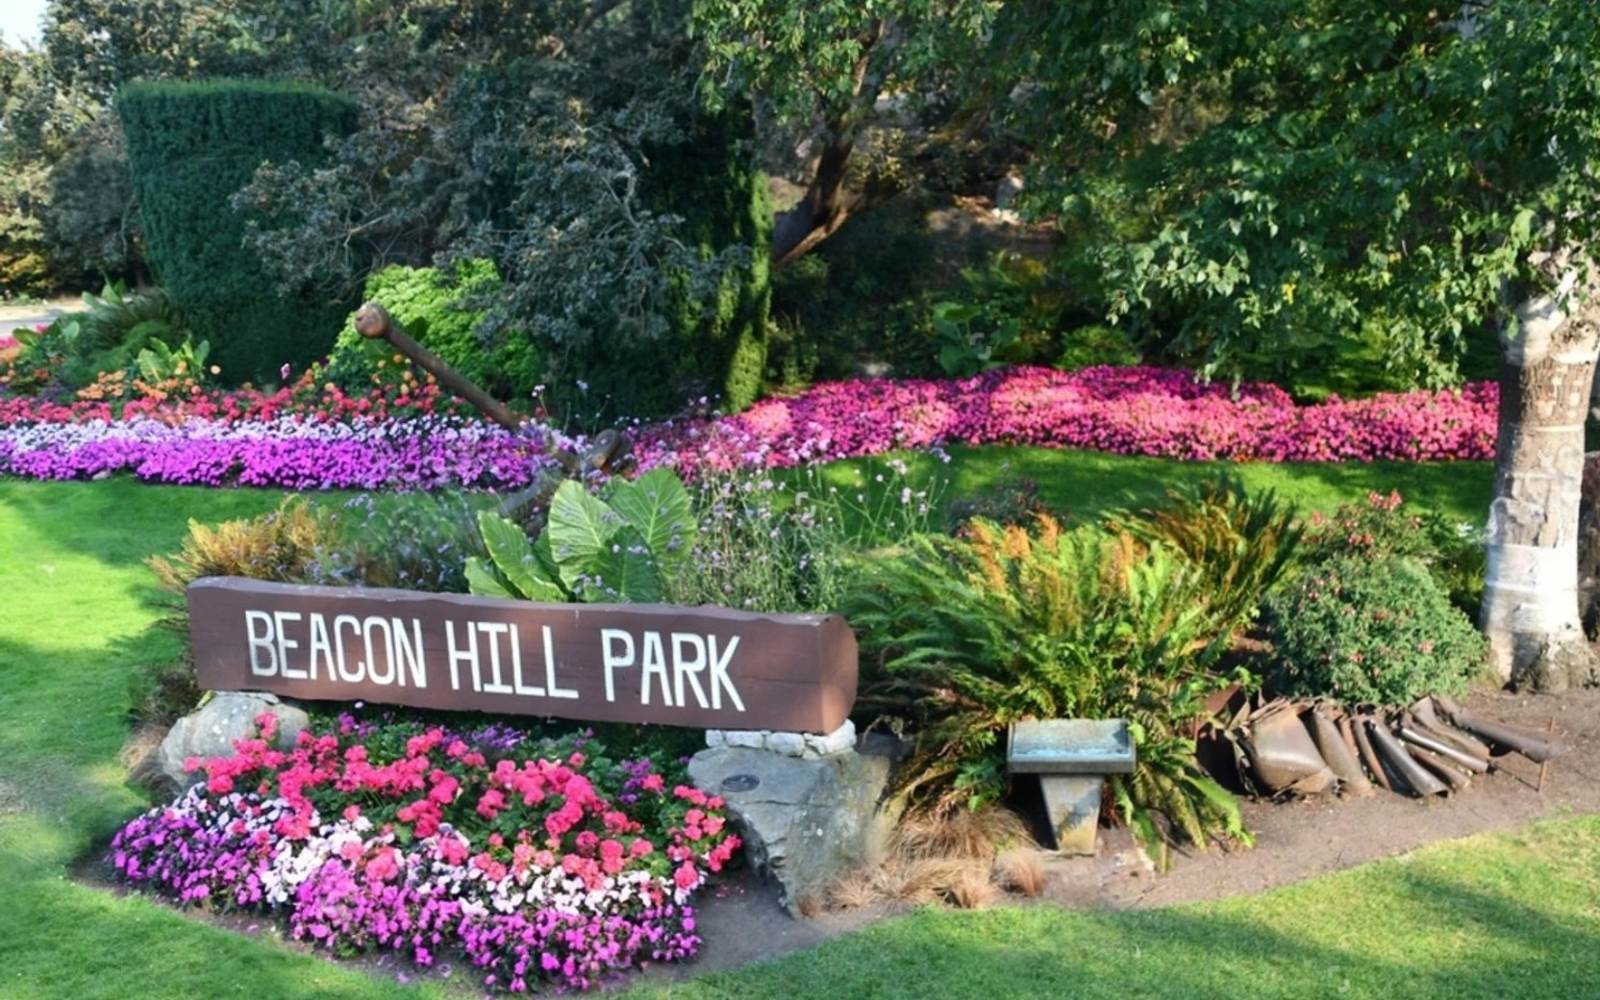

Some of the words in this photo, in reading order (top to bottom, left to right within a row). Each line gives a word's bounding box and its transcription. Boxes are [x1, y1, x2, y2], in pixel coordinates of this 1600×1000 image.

[244, 609, 428, 689] BEACON
[445, 620, 580, 699] HILL
[601, 628, 747, 712] PARK
